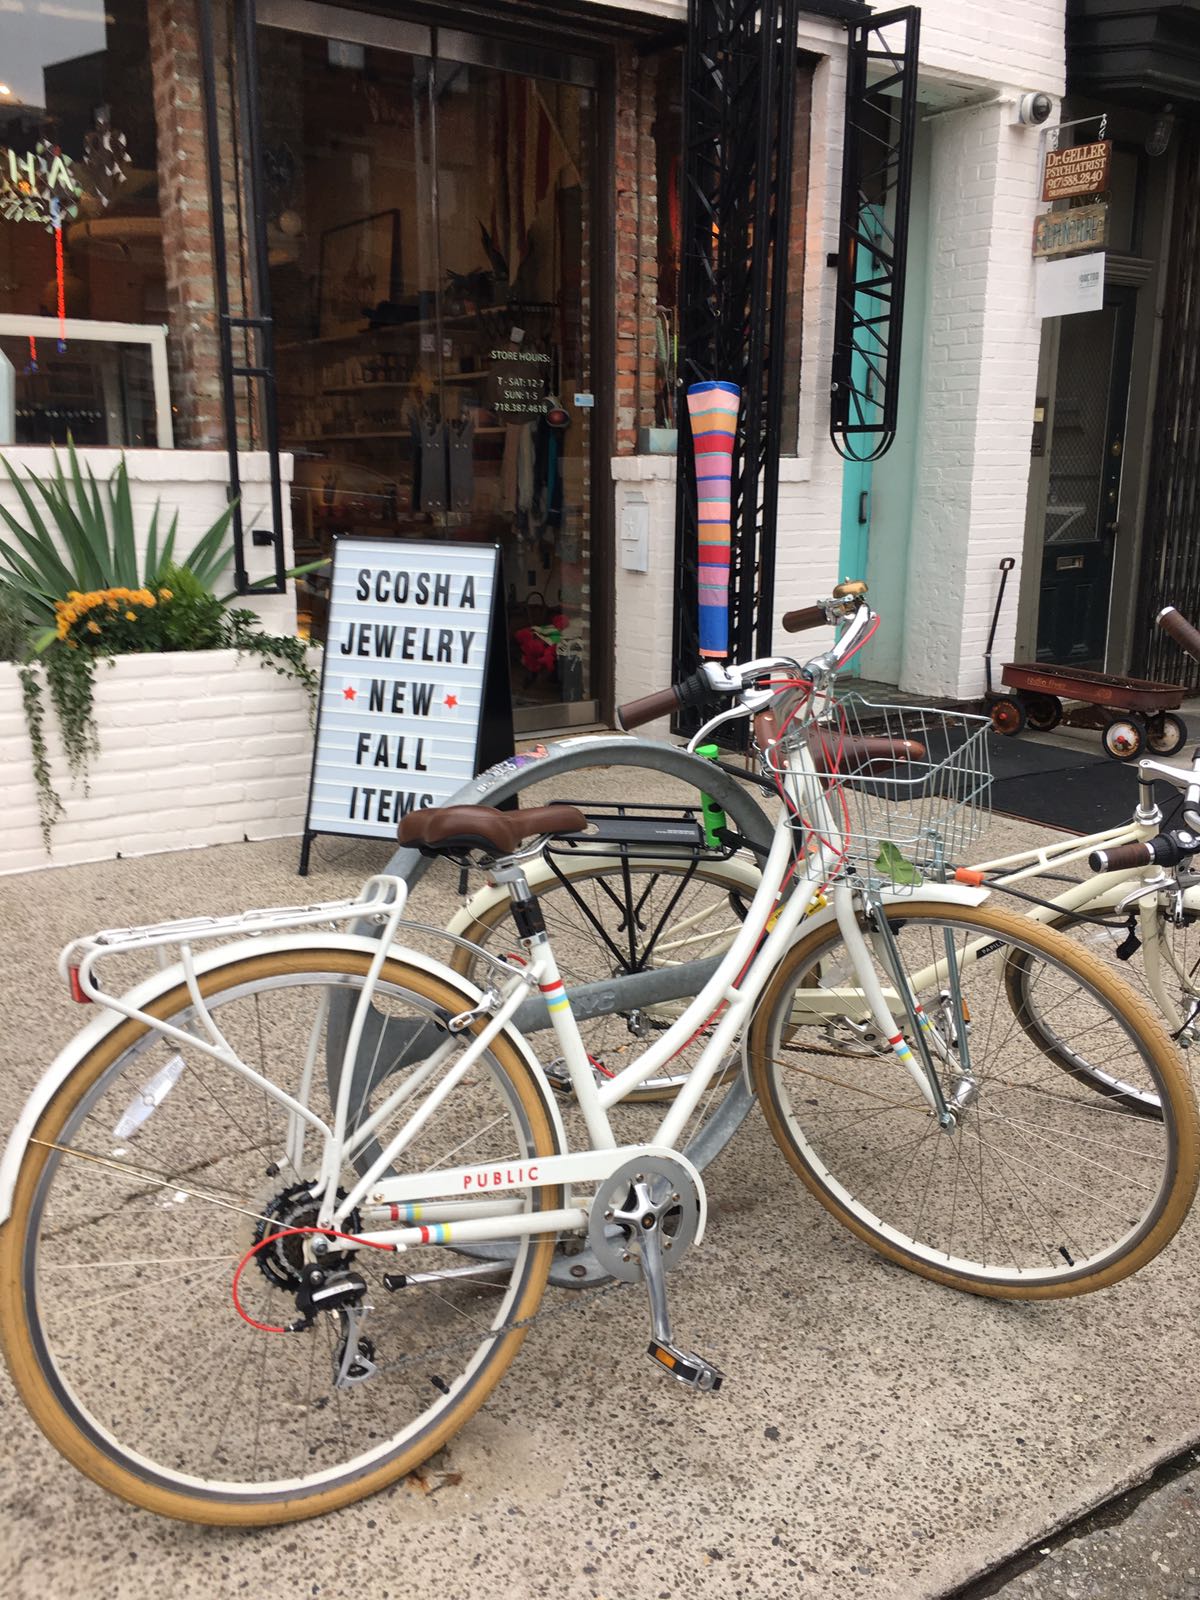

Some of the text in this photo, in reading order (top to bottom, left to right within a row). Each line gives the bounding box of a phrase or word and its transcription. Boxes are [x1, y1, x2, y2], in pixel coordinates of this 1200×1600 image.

[1046, 157, 1107, 179] PSYCHIATRIST
[490, 350, 551, 363] STORE HOURS:
[508, 377, 526, 387] SAT:
[504, 390, 524, 400] SUN:
[494, 402, 548, 414] 718.387.4618
[356, 568, 476, 609] SCOSHA
[340, 622, 476, 664] JEWELRY
[369, 679, 435, 717] NEW
[356, 732, 428, 772] FALL
[463, 1166, 539, 1190] PUBLIC
